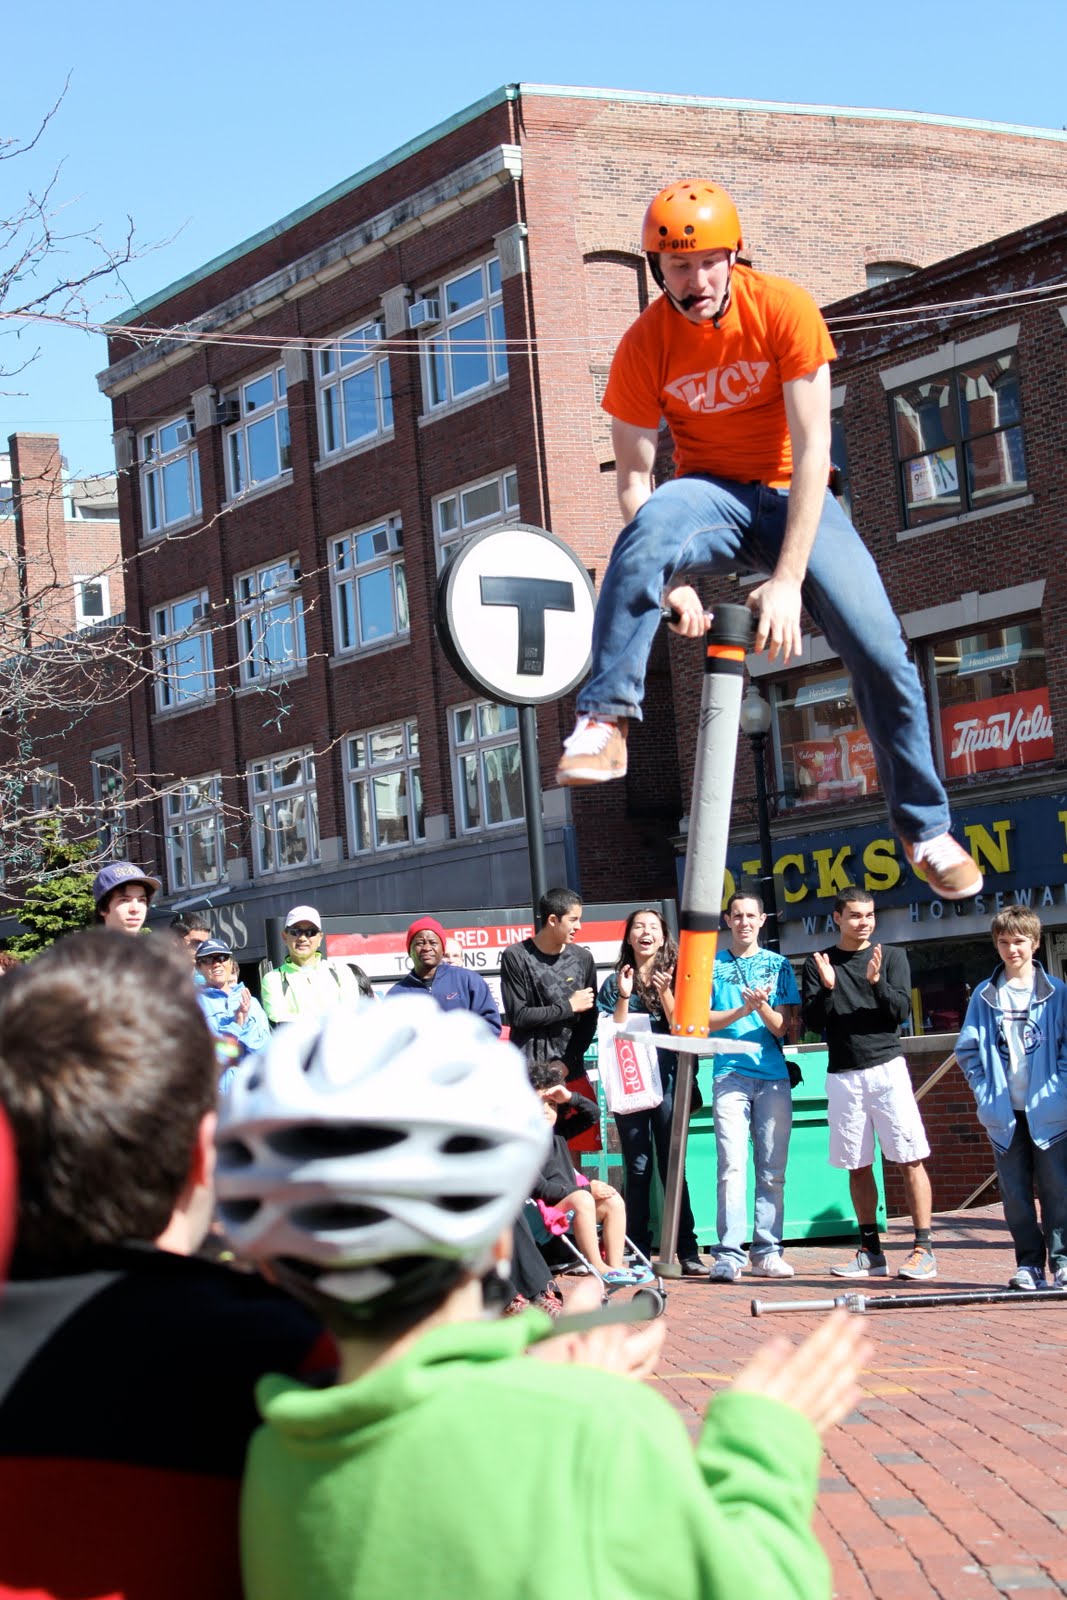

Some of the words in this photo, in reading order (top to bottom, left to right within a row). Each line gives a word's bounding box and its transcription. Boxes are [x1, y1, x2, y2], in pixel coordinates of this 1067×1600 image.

[479, 575, 575, 677] T
[721, 820, 1010, 911] CKSN
[909, 884, 1067, 922] HOUSEWA
[196, 903, 248, 950] ESS
[454, 930, 489, 947] RED
[496, 928, 532, 945] LINE
[620, 1045, 641, 1091] COOP
